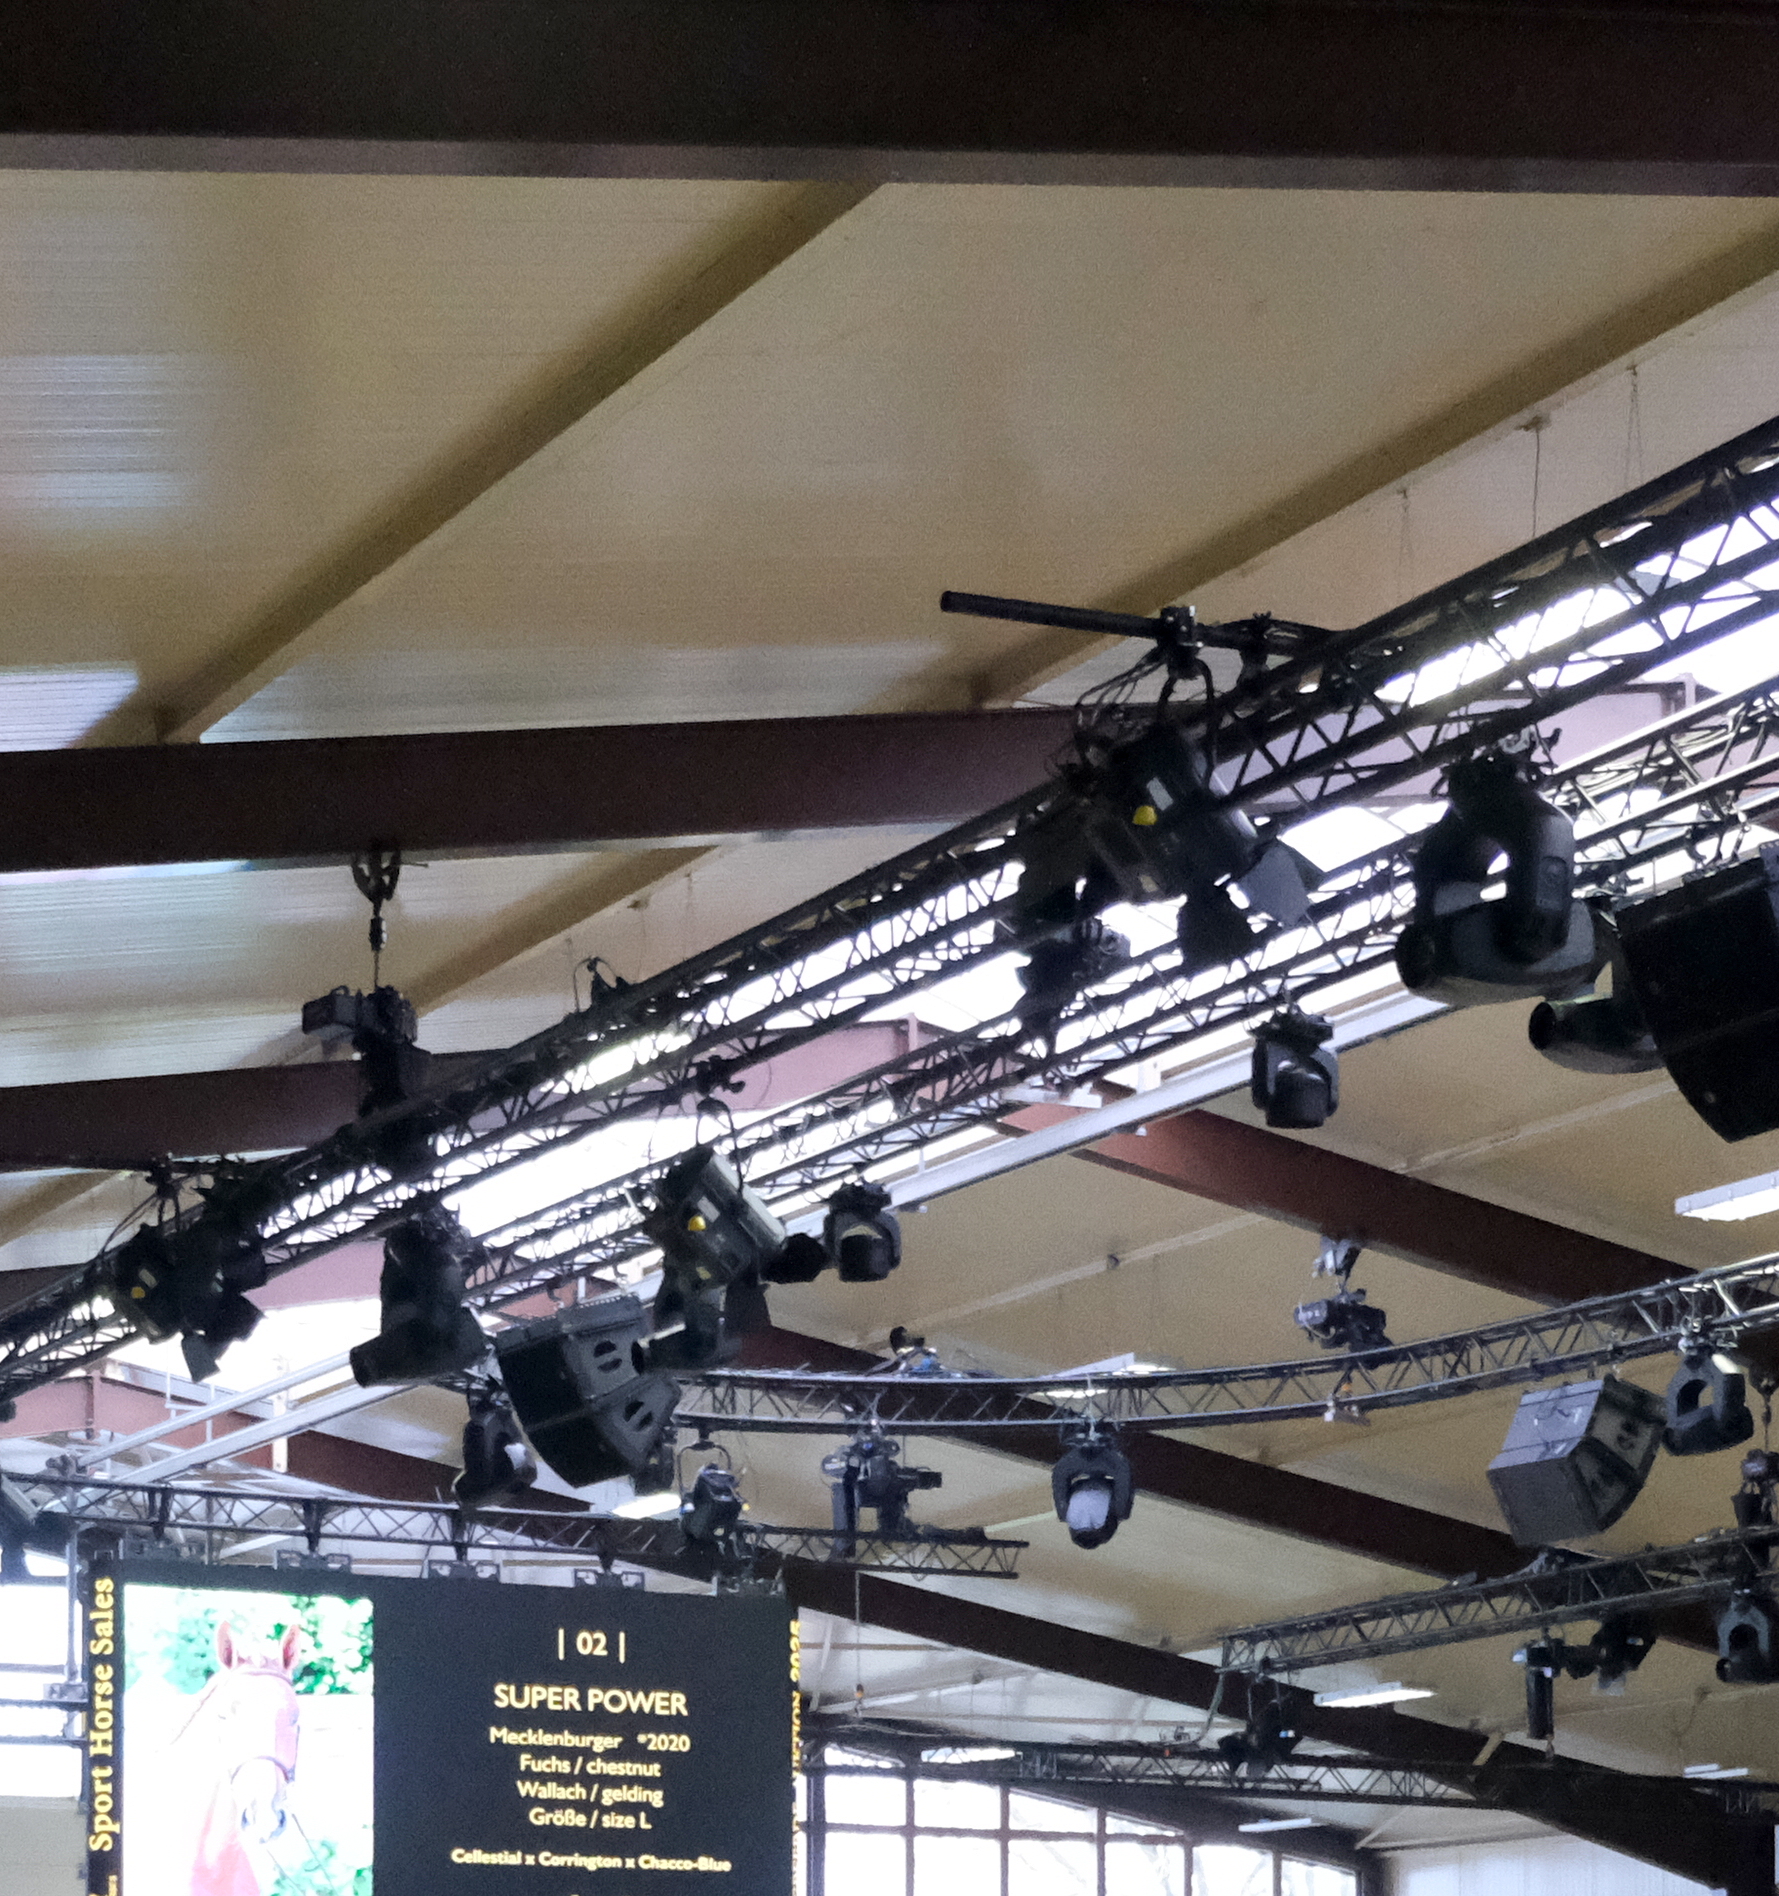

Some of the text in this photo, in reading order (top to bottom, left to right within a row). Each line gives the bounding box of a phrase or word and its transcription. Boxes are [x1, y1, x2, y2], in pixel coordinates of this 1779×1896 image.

[576, 1632, 608, 1656] 02
[494, 1682, 688, 1716] SUPER POWER
[88, 1577, 120, 1852] Sport Horse Sales
[489, 1726, 623, 1753] Mecklenburger
[520, 1754, 571, 1774] Fuchs
[586, 1758, 661, 1777] chestnut
[517, 1780, 586, 1800] Wallach
[602, 1785, 664, 1808] gelding
[529, 1807, 587, 1827] Größe
[602, 1811, 635, 1828] size
[640, 1812, 652, 1829] L
[451, 1848, 732, 1872] Cellestial x Corrington x Chacco-Blue
